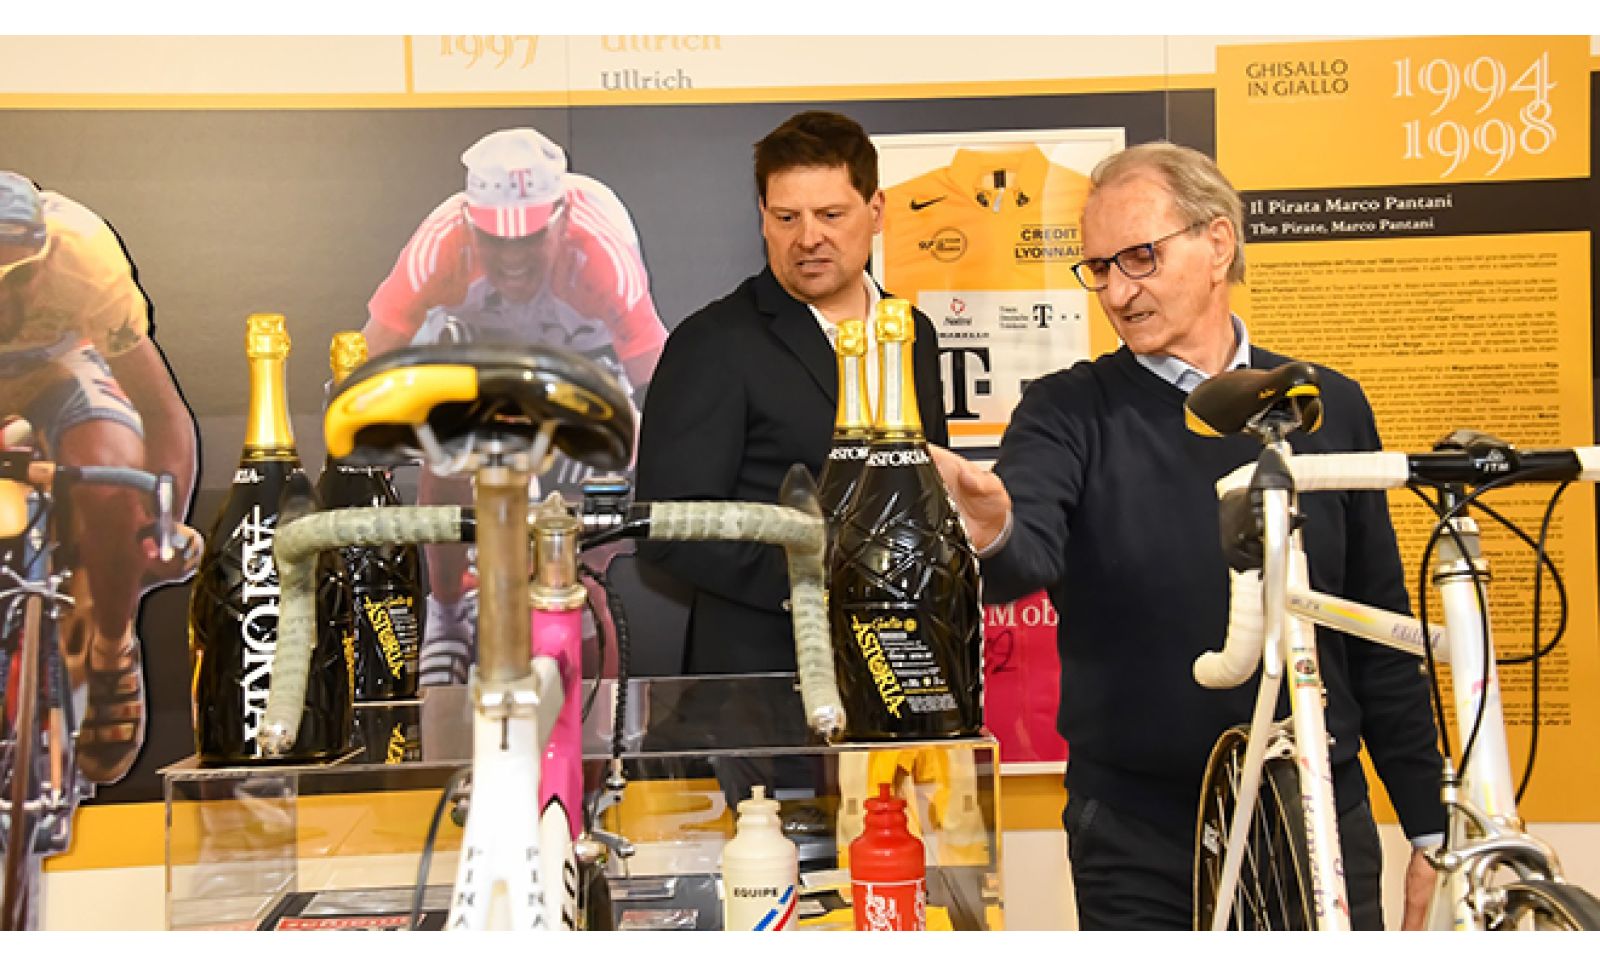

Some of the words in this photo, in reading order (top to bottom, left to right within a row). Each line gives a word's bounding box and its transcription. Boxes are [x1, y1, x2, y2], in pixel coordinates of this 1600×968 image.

[601, 69, 692, 90] Ullrich
[1246, 59, 1349, 80] GHISALLO
[1247, 81, 1269, 97] IN
[1272, 78, 1349, 96] GIALLO
[1392, 51, 1558, 116] 1994
[1402, 99, 1558, 179] 1998
[1250, 201, 1263, 215] Il
[1268, 199, 1320, 214] Pirata
[1326, 197, 1380, 214] Marco
[1386, 193, 1453, 211] Pantani
[1021, 228, 1078, 242] CREDIT
[1250, 223, 1278, 236] The
[1281, 221, 1328, 236] Pirate,
[1332, 219, 1376, 233] Marco
[1380, 217, 1435, 231] Pantani
[733, 887, 778, 898] EQUIPE
